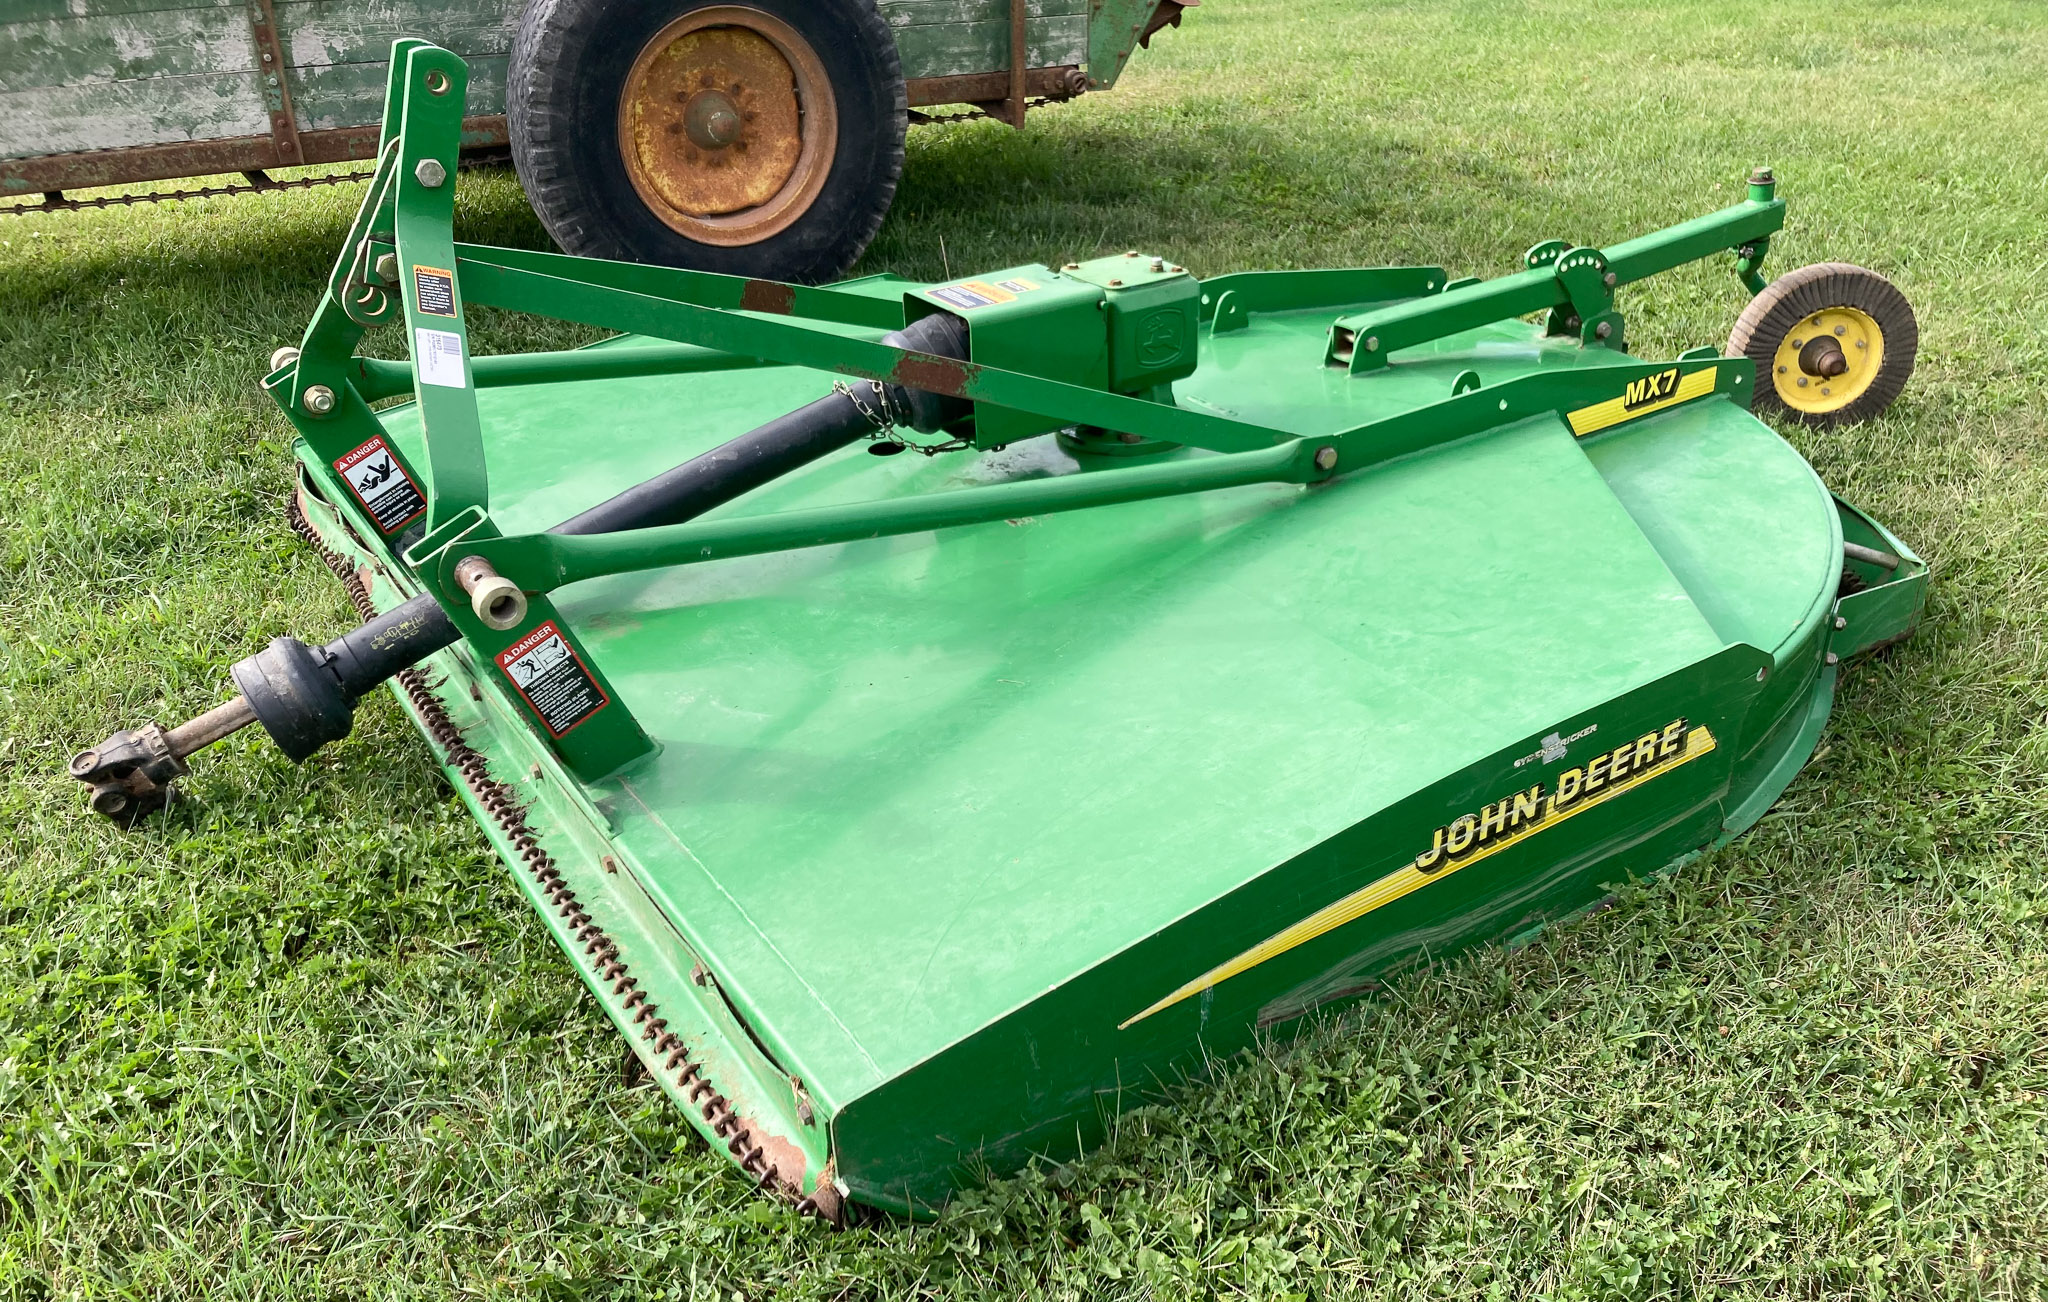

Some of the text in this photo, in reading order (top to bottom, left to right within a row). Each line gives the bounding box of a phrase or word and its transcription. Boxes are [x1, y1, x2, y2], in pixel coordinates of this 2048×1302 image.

[422, 267, 451, 277] WARNING
[1623, 367, 1681, 411] MX7
[346, 438, 382, 464] DANGER
[511, 626, 552, 656] DANGER
[529, 659, 569, 689] THROWN OBJECTS
[550, 687, 589, 716] ROTATING BLADES
[1416, 717, 1688, 874] JOHN DEERE
